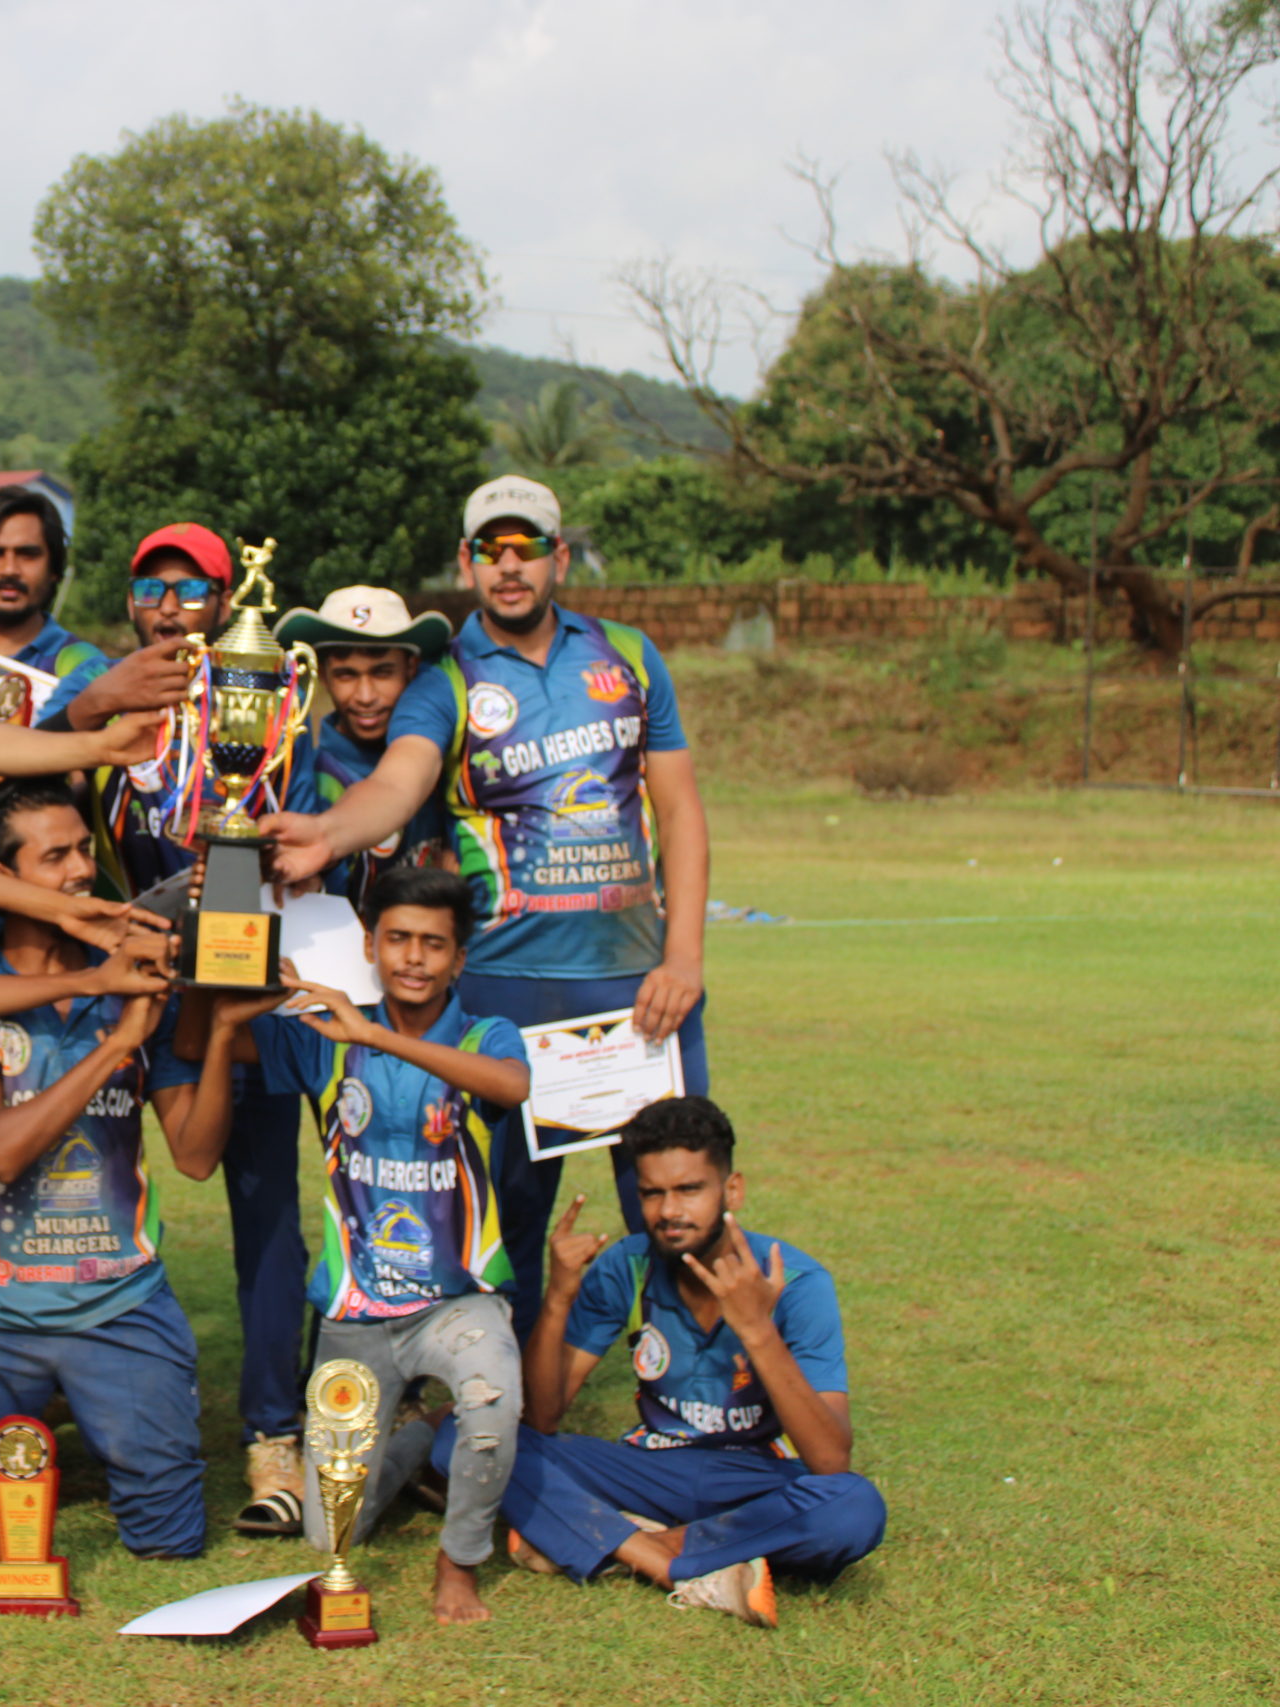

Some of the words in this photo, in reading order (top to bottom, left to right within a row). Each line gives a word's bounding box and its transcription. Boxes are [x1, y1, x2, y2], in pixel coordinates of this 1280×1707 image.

[502, 740, 545, 777] GOA
[541, 720, 614, 768] HEROES
[547, 842, 631, 865] MUMBAI
[533, 860, 642, 886] CHARGERS
[106, 1088, 135, 1117] CUP
[430, 1158, 458, 1192] CUP
[35, 1215, 111, 1235] MUMBAI
[23, 1235, 121, 1255] CHARGERS
[727, 1405, 763, 1432] CUP
